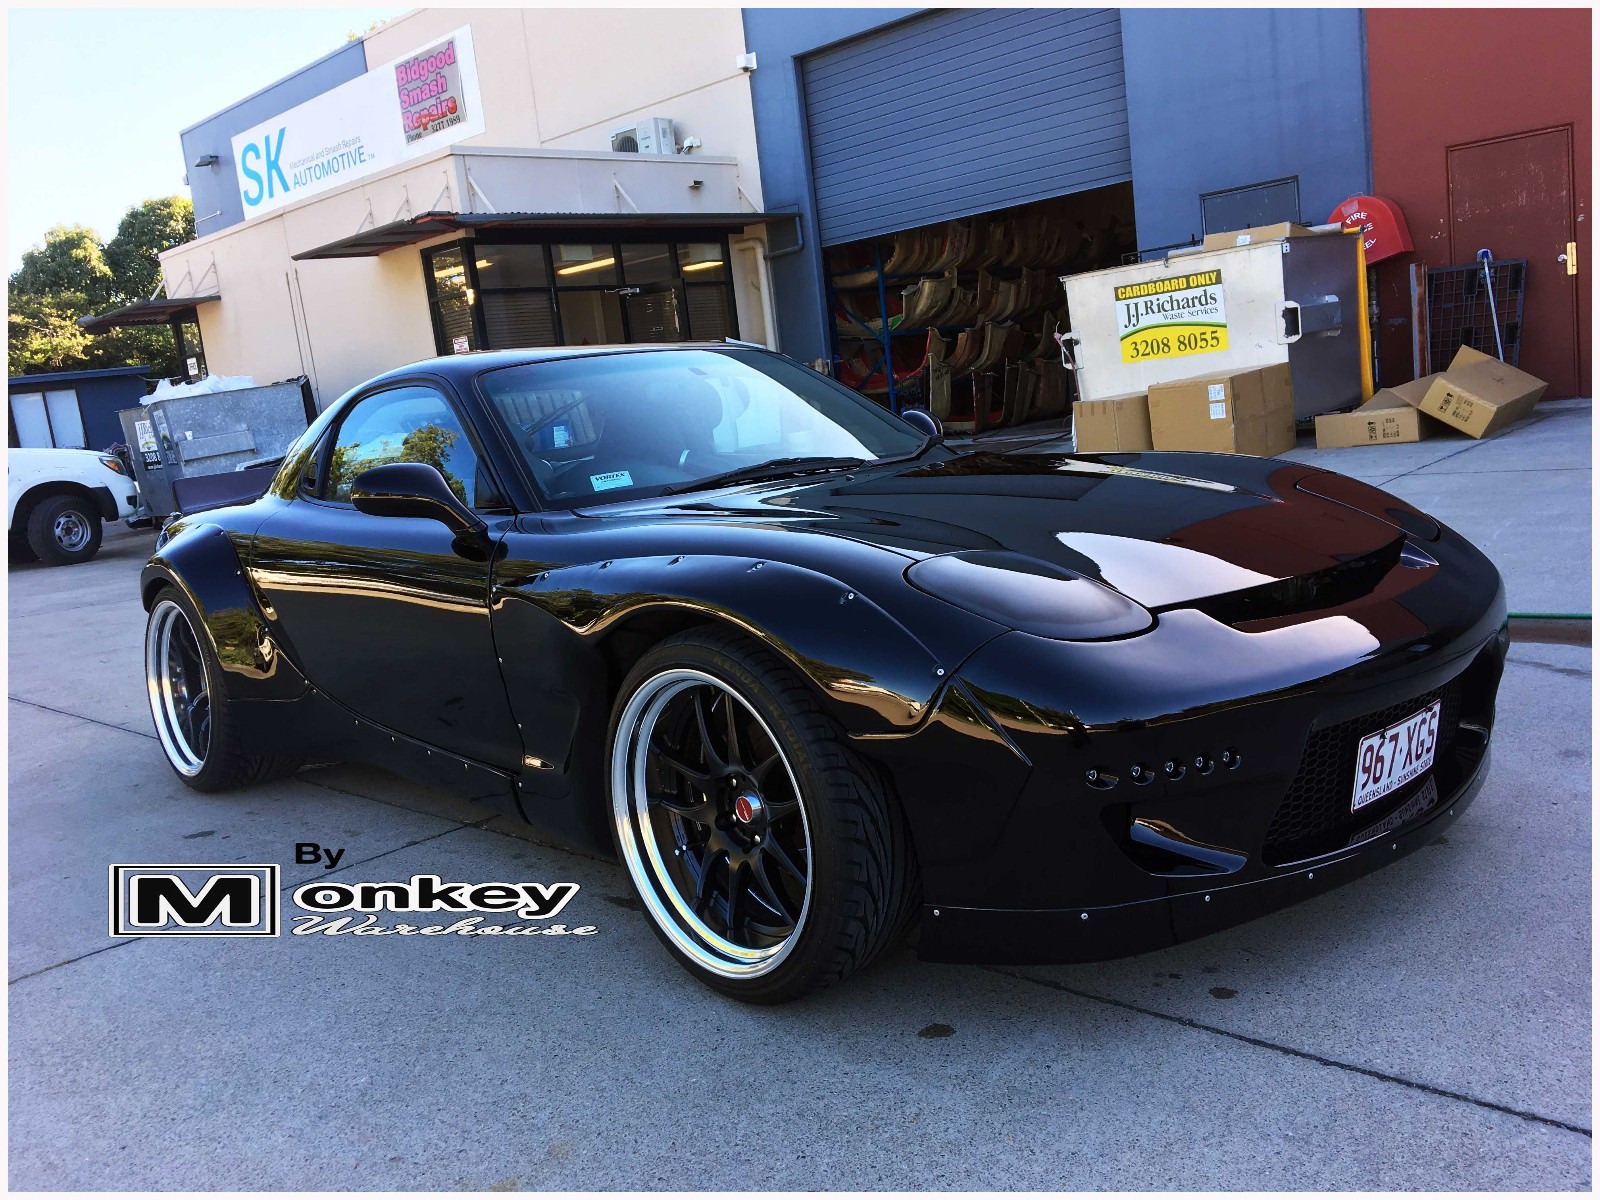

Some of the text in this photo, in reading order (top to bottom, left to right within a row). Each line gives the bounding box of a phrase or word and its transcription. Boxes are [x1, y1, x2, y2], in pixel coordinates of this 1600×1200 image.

[395, 41, 456, 88] Bidgood
[400, 72, 448, 109] Smash
[402, 96, 458, 134] Repairs
[241, 126, 291, 207] SK
[293, 145, 366, 189] AUTOMOTIVE
[1345, 212, 1367, 224] FIRE
[1117, 271, 1217, 299] CARDBOARD ONLY
[1162, 306, 1219, 321] Waste Services
[1130, 330, 1220, 359] 3208 8055
[594, 472, 625, 481] VORTEX
[1357, 780, 1393, 806] QUEENSLAND
[1397, 764, 1419, 786] SUNSHINE
[1419, 756, 1432, 772] STATE
